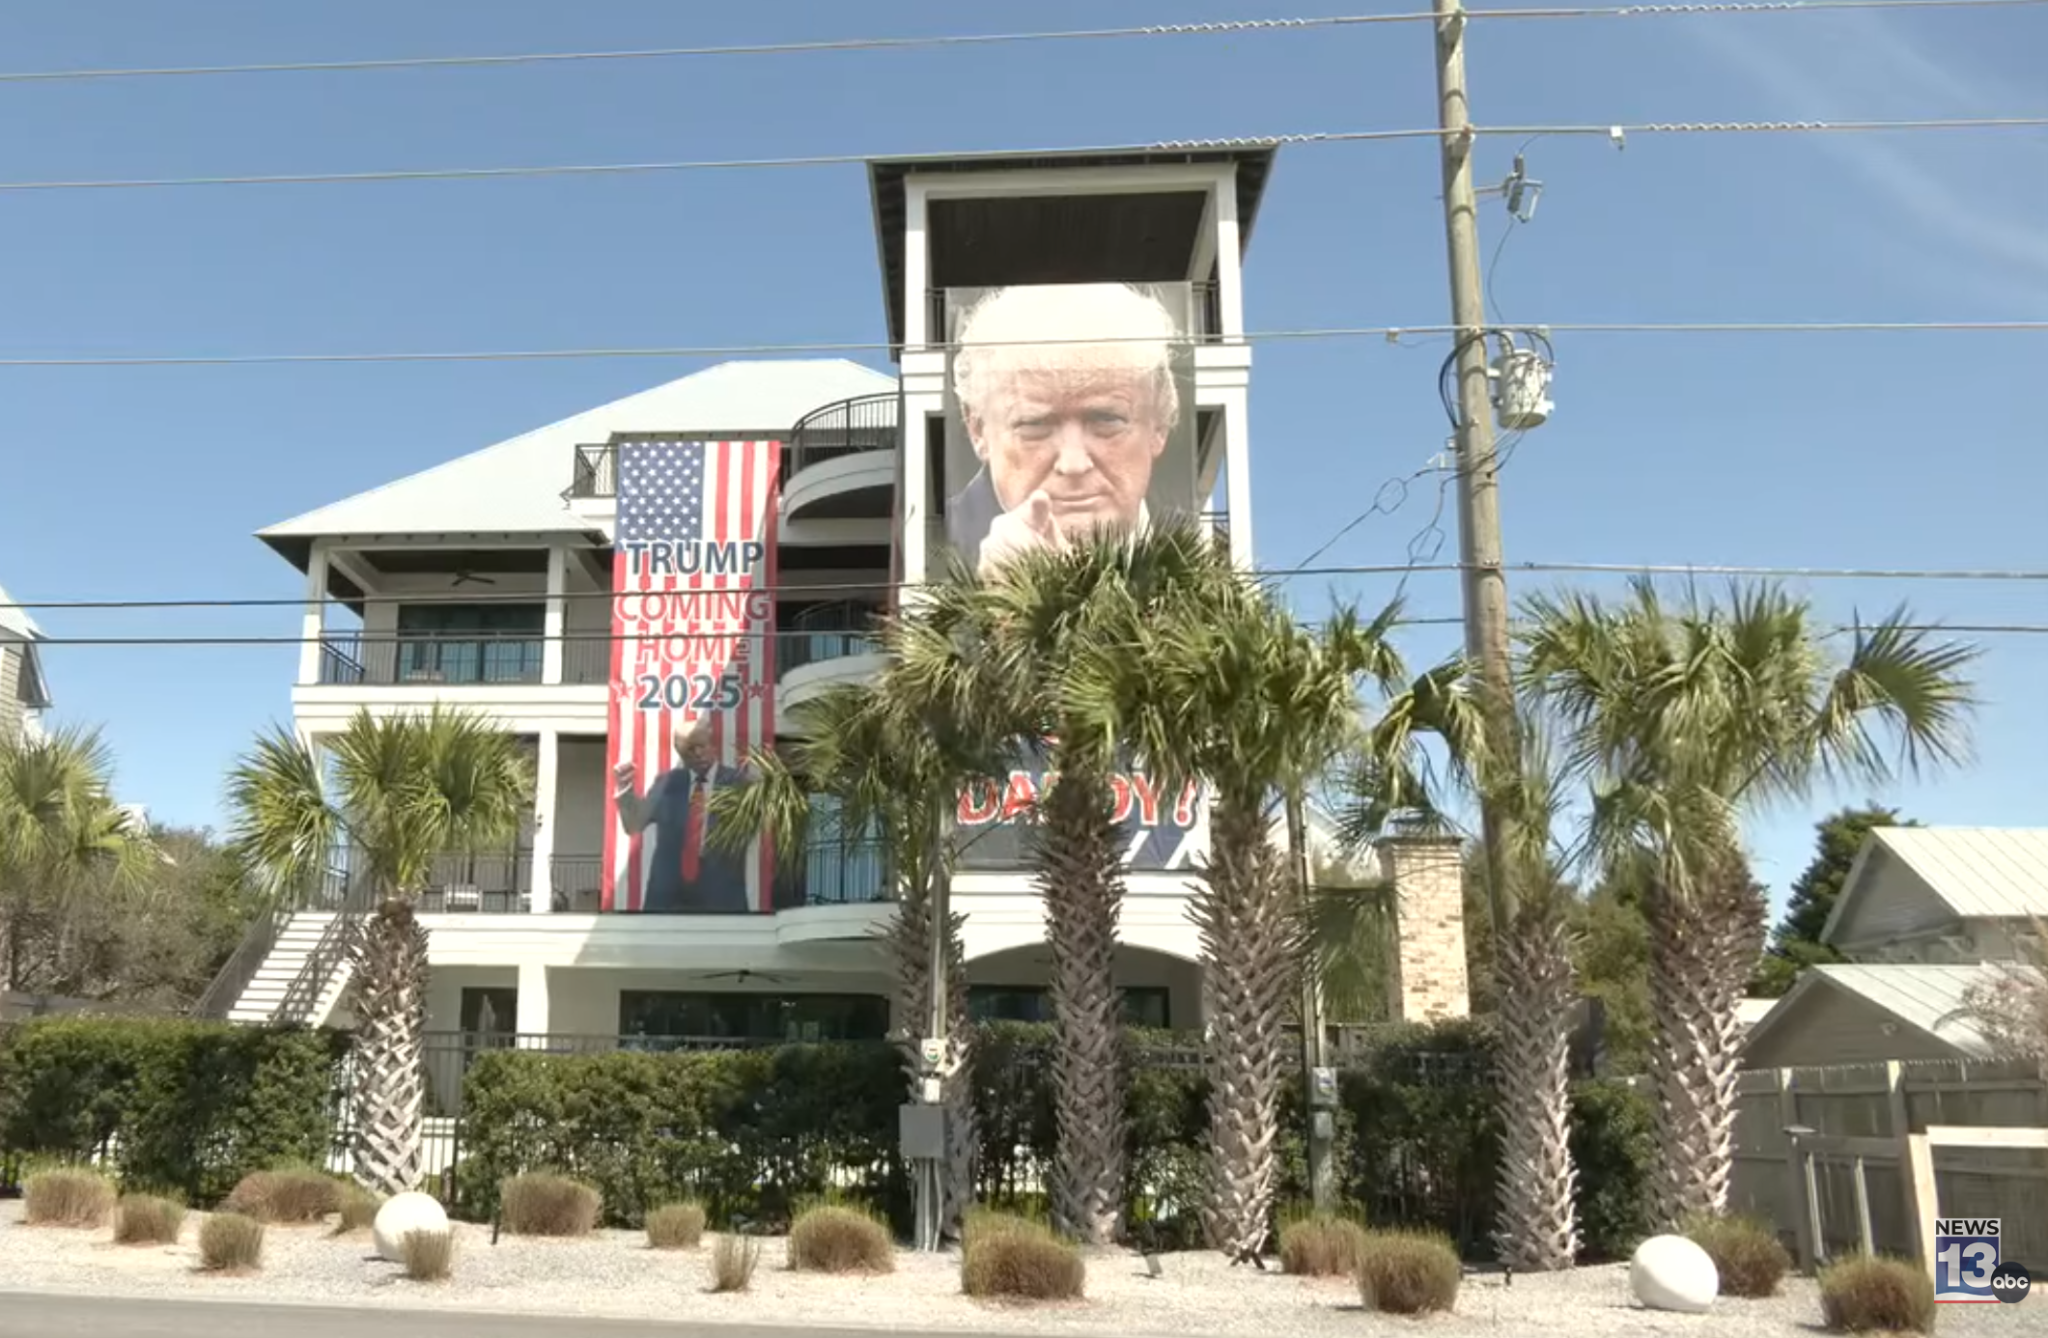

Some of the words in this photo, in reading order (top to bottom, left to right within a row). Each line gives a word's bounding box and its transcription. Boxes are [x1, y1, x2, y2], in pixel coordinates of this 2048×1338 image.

[625, 541, 764, 574] TRUMP
[614, 592, 770, 621] COMING
[635, 632, 749, 663] HOME
[638, 674, 741, 709] 2025
